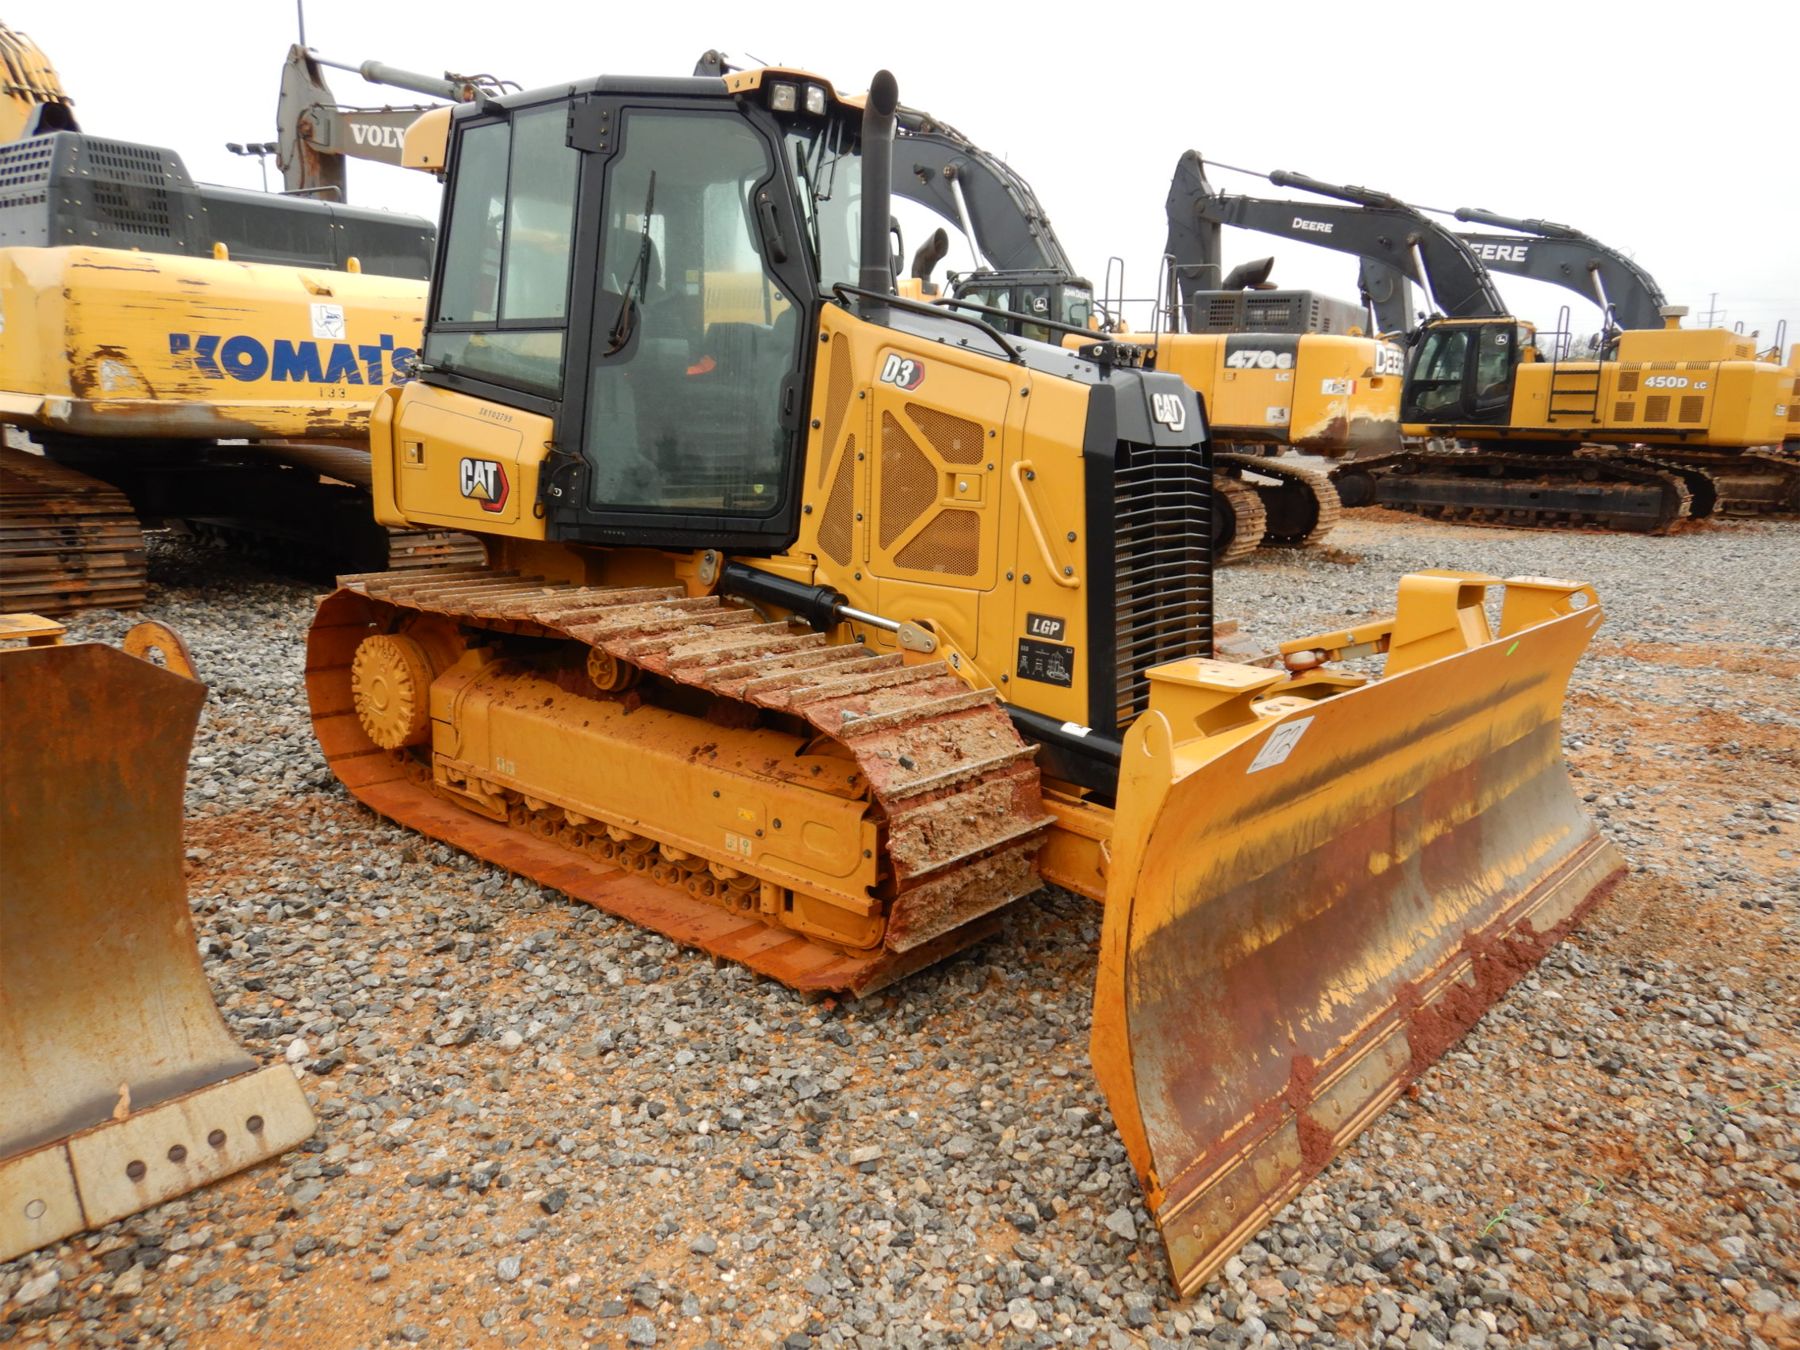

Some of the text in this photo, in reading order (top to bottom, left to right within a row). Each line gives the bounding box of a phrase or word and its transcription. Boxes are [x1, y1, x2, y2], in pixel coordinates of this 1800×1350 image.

[350, 123, 404, 148] VOLV
[1292, 217, 1334, 233] DEERE
[1469, 243, 1528, 262] EERE
[168, 333, 418, 386] KOMATS
[880, 353, 915, 387] D3
[1226, 349, 1293, 370] 470G
[1274, 372, 1291, 382] LC
[1644, 375, 1708, 390] 450D LC
[1152, 393, 1180, 423] CAT
[460, 457, 498, 500] CAT
[1032, 618, 1061, 636] LGP
